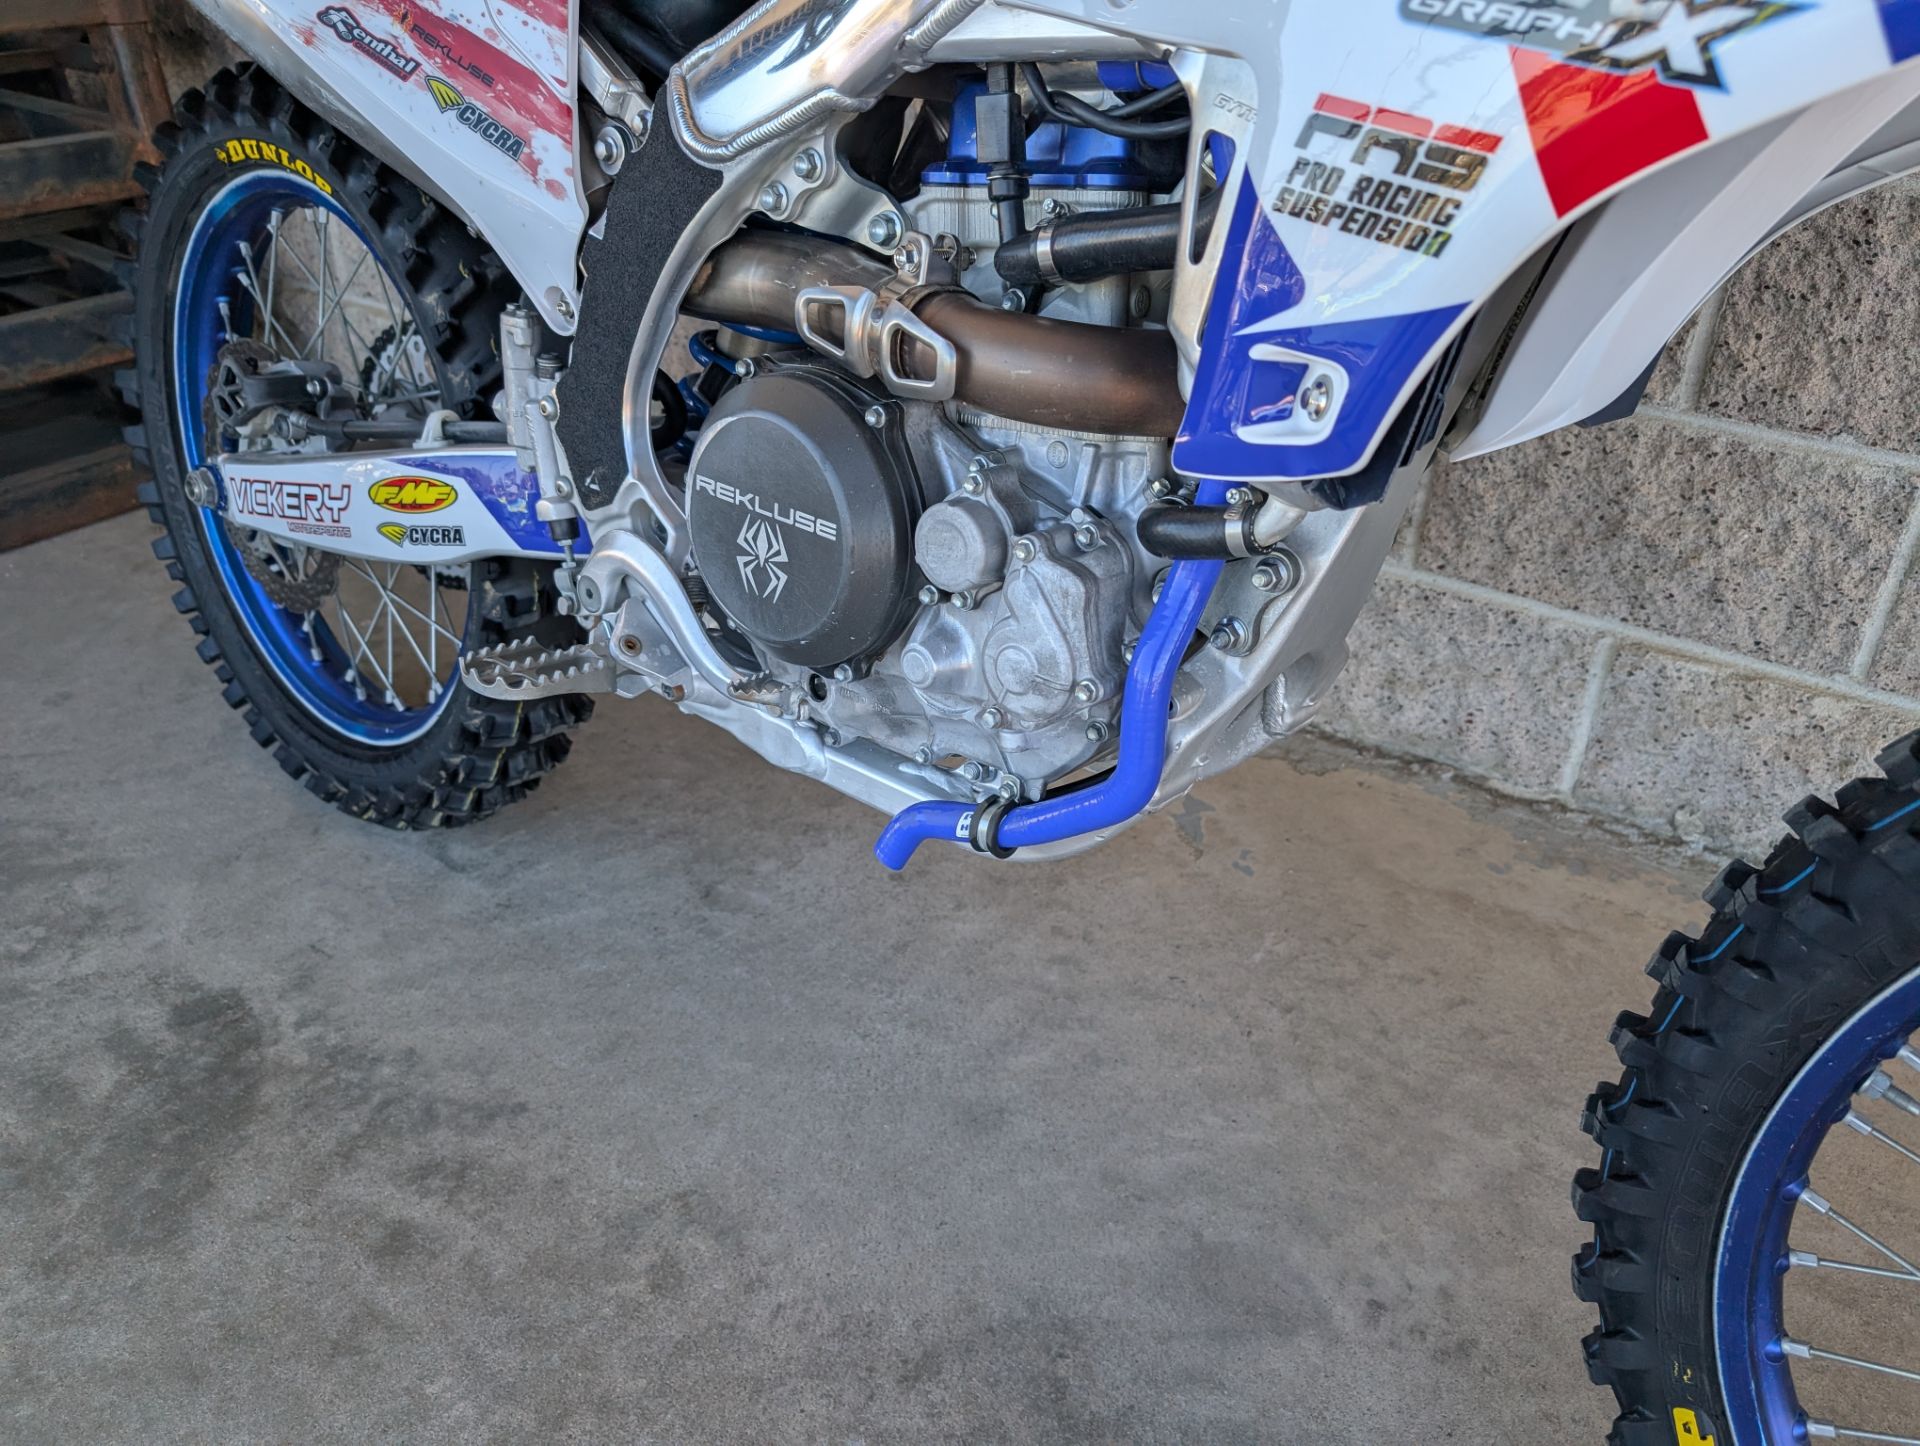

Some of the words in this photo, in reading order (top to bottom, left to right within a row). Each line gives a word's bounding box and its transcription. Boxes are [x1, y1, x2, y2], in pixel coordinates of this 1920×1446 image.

[411, 24, 495, 88] REKLUSE
[457, 103, 526, 160] CYCRA
[225, 138, 333, 196] DUNLOP
[1286, 155, 1346, 197] PRO
[1348, 173, 1463, 227] RACING
[1271, 187, 1453, 259] SUSPENSION
[230, 477, 352, 523] VICKERY
[373, 480, 454, 504] FMF
[695, 474, 838, 541] REKLUSE
[408, 526, 465, 545] CYCRA
